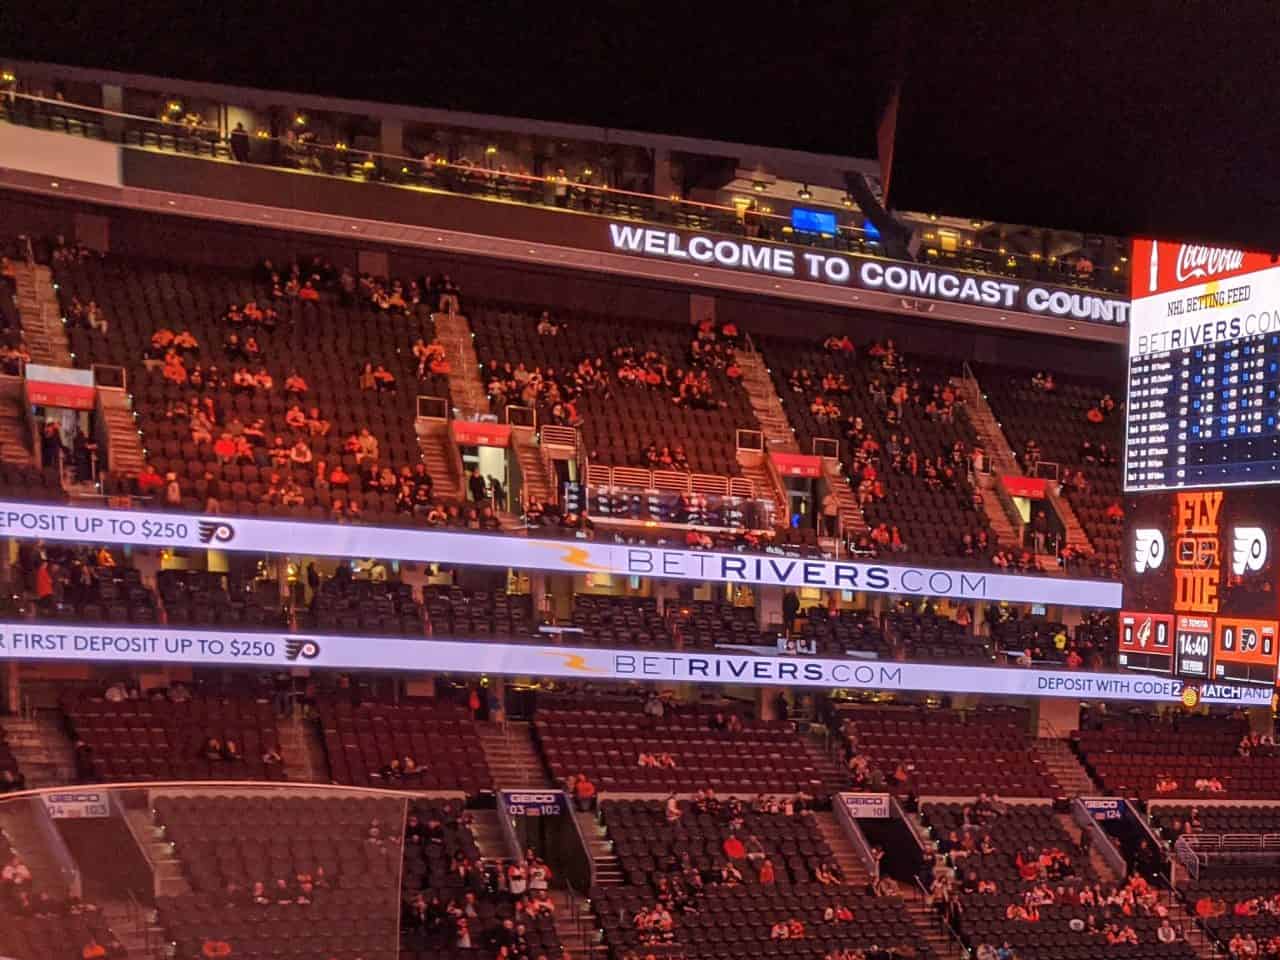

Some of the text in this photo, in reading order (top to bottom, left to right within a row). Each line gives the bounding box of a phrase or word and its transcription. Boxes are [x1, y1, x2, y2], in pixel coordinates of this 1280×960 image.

[610, 223, 794, 274] WELCOME
[804, 252, 850, 283] TO
[861, 262, 1020, 307] COMCAST
[1167, 284, 1252, 317] NHL BETTING FEED
[1175, 491, 1224, 534] FLY
[74, 515, 103, 533] UP
[107, 518, 136, 536] TO
[142, 519, 188, 541] $250
[627, 547, 988, 598] BETRIVERS.COM
[1173, 568, 1220, 613] DIE
[12, 633, 276, 659] FIRST DEPOSIT UP TO $250
[1158, 625, 1165, 643] 0
[1180, 634, 1208, 656] 14:40
[1225, 629, 1233, 648] 0
[615, 655, 903, 686] BETRIVERS.COM
[1037, 676, 1093, 692] DEPOSIT
[1094, 678, 1131, 694] WITH
[1133, 681, 1170, 696] CODE
[510, 793, 556, 803] GEICO
